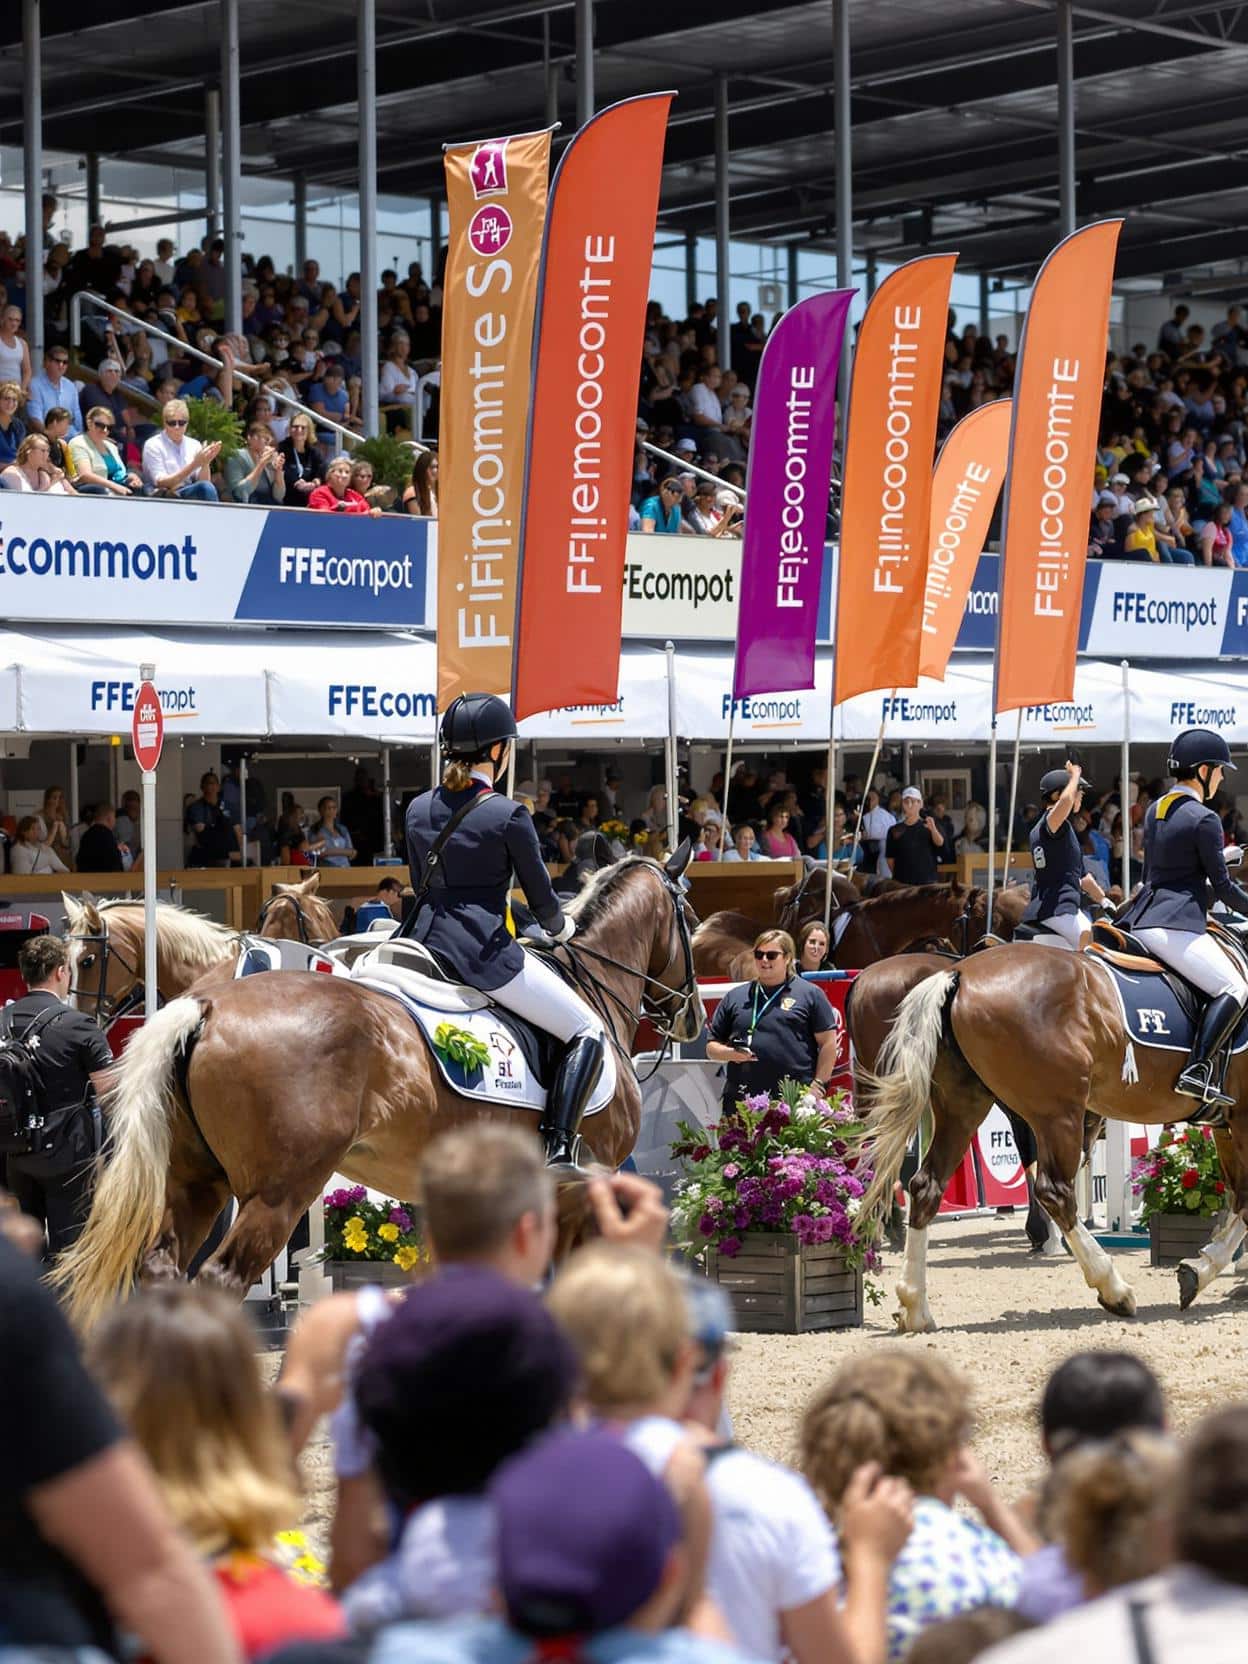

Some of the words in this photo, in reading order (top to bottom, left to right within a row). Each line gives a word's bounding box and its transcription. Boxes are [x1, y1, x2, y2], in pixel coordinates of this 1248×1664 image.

[0, 521, 198, 581] commont
[280, 547, 413, 596] FFEcompot
[1113, 591, 1217, 632] FFEcompot
